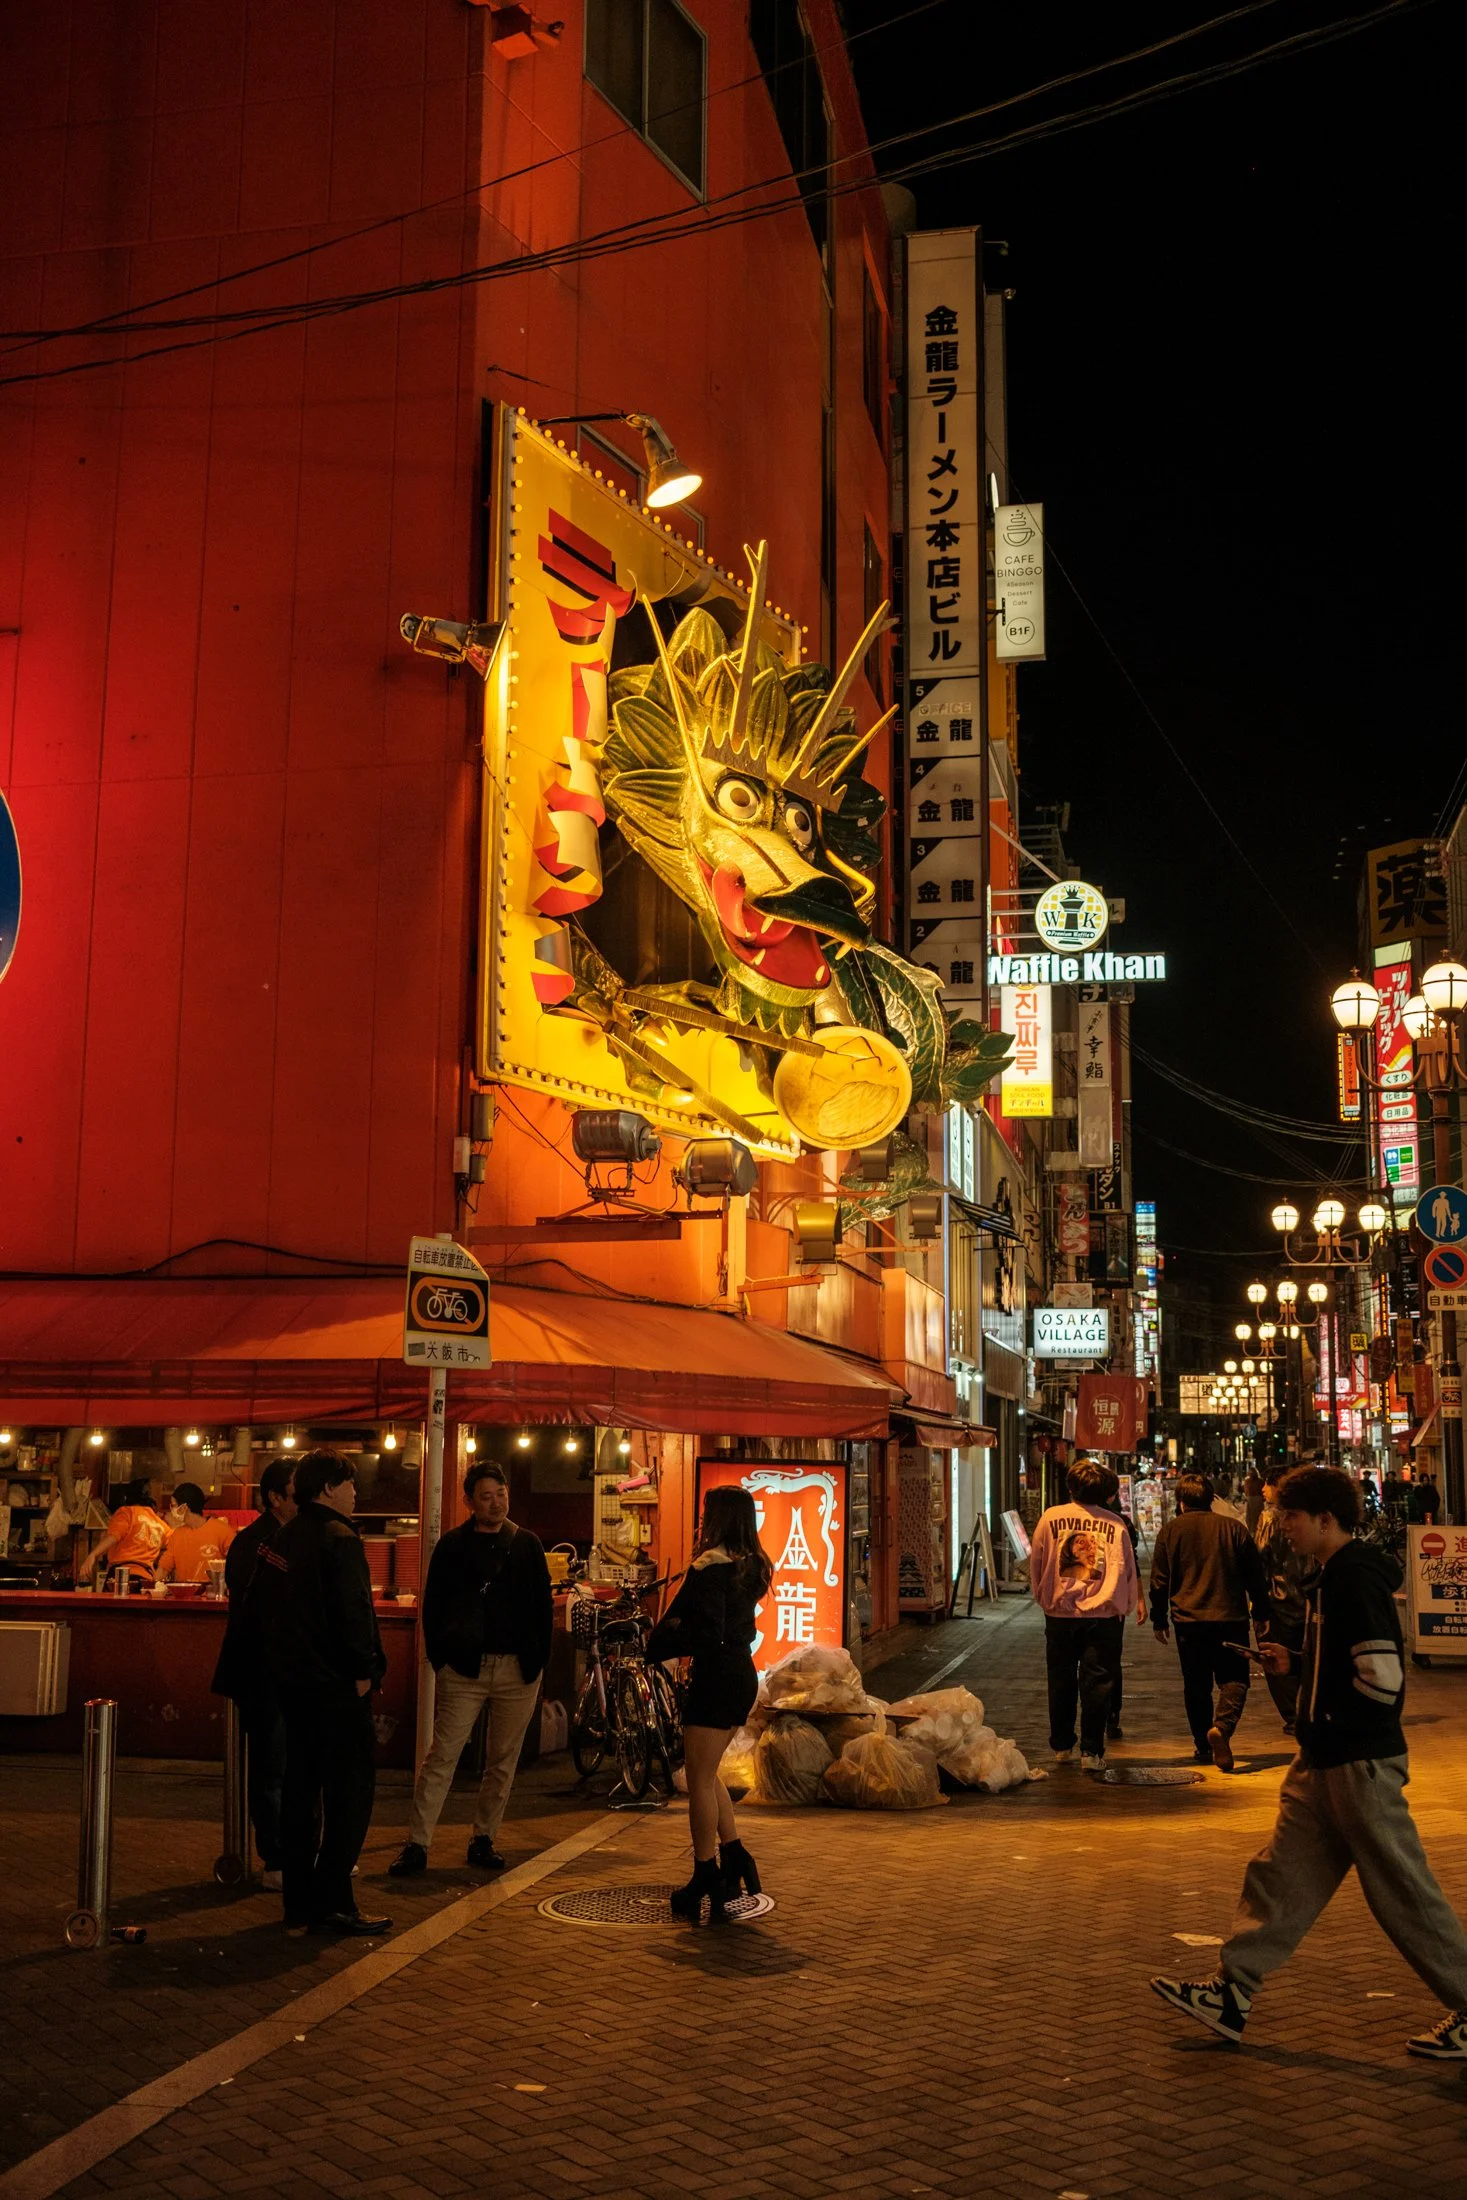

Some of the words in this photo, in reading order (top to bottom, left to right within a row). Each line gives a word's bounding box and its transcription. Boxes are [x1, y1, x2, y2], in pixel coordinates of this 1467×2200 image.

[925, 305, 961, 661] 金龍ラーメン本店ビル
[1005, 554, 1034, 565] CAFE
[997, 566, 1042, 578] BINGGO
[1009, 626, 1030, 636] B1F
[915, 685, 925, 697] 5
[916, 718, 973, 743] 金龍
[915, 763, 925, 776] 4
[917, 798, 974, 823] 金龍
[916, 844, 926, 857] 3
[917, 879, 974, 904] 金龍
[1042, 910, 1061, 928] W
[1082, 912, 1099, 930] K
[916, 925, 926, 937] 2
[988, 953, 1079, 985] Waffle
[1084, 952, 1166, 981] Khan
[1015, 993, 1042, 1076] 진짜루
[1386, 1073, 1408, 1084] くすり
[1387, 1104, 1409, 1118] 日用品
[1113, 1143, 1122, 1174] スナック
[1041, 1313, 1102, 1326] OSAKA
[1037, 1329, 1106, 1341] VILLAGE
[427, 1343, 468, 1362] 大阪市
[1051, 1346, 1103, 1354] Restaurant
[775, 1506, 818, 1643] 金龍
